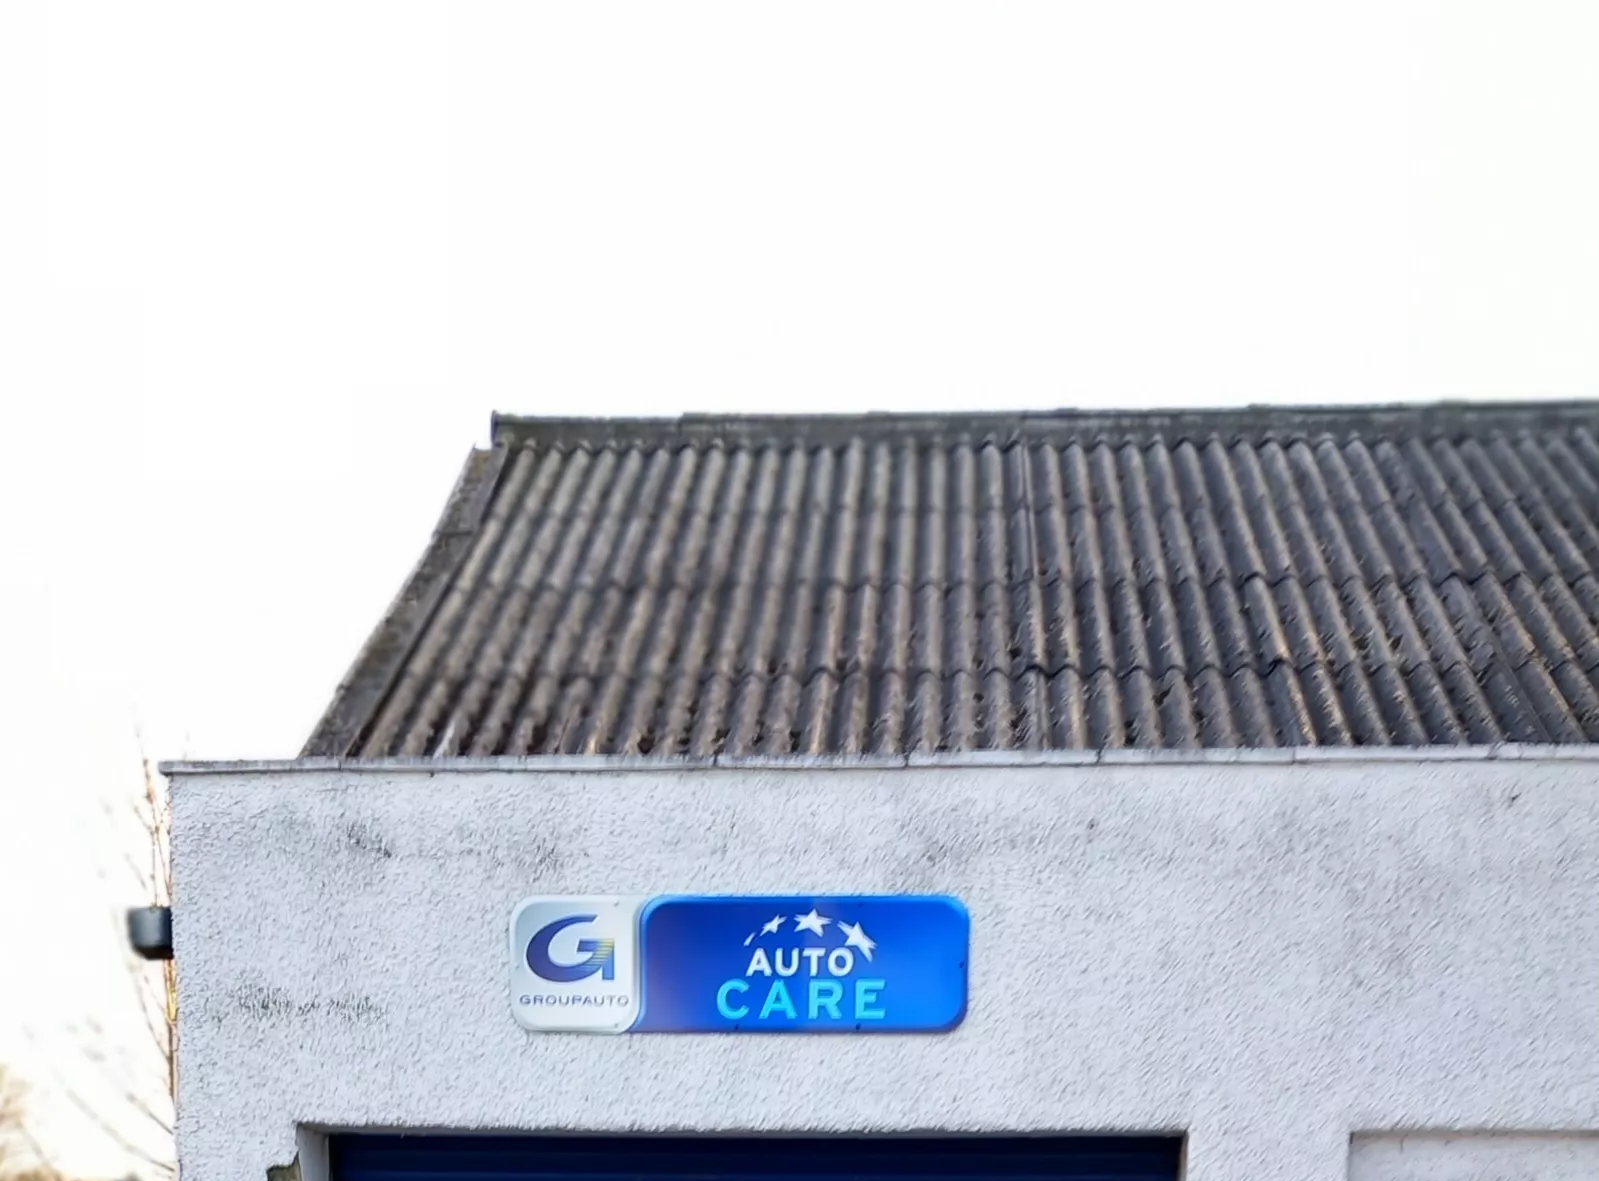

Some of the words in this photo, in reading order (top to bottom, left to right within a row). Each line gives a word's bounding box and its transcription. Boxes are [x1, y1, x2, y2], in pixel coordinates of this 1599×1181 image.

[746, 947, 854, 977] AUTO
[519, 994, 630, 1008] GROUPAUTO
[716, 979, 886, 1020] CARE
